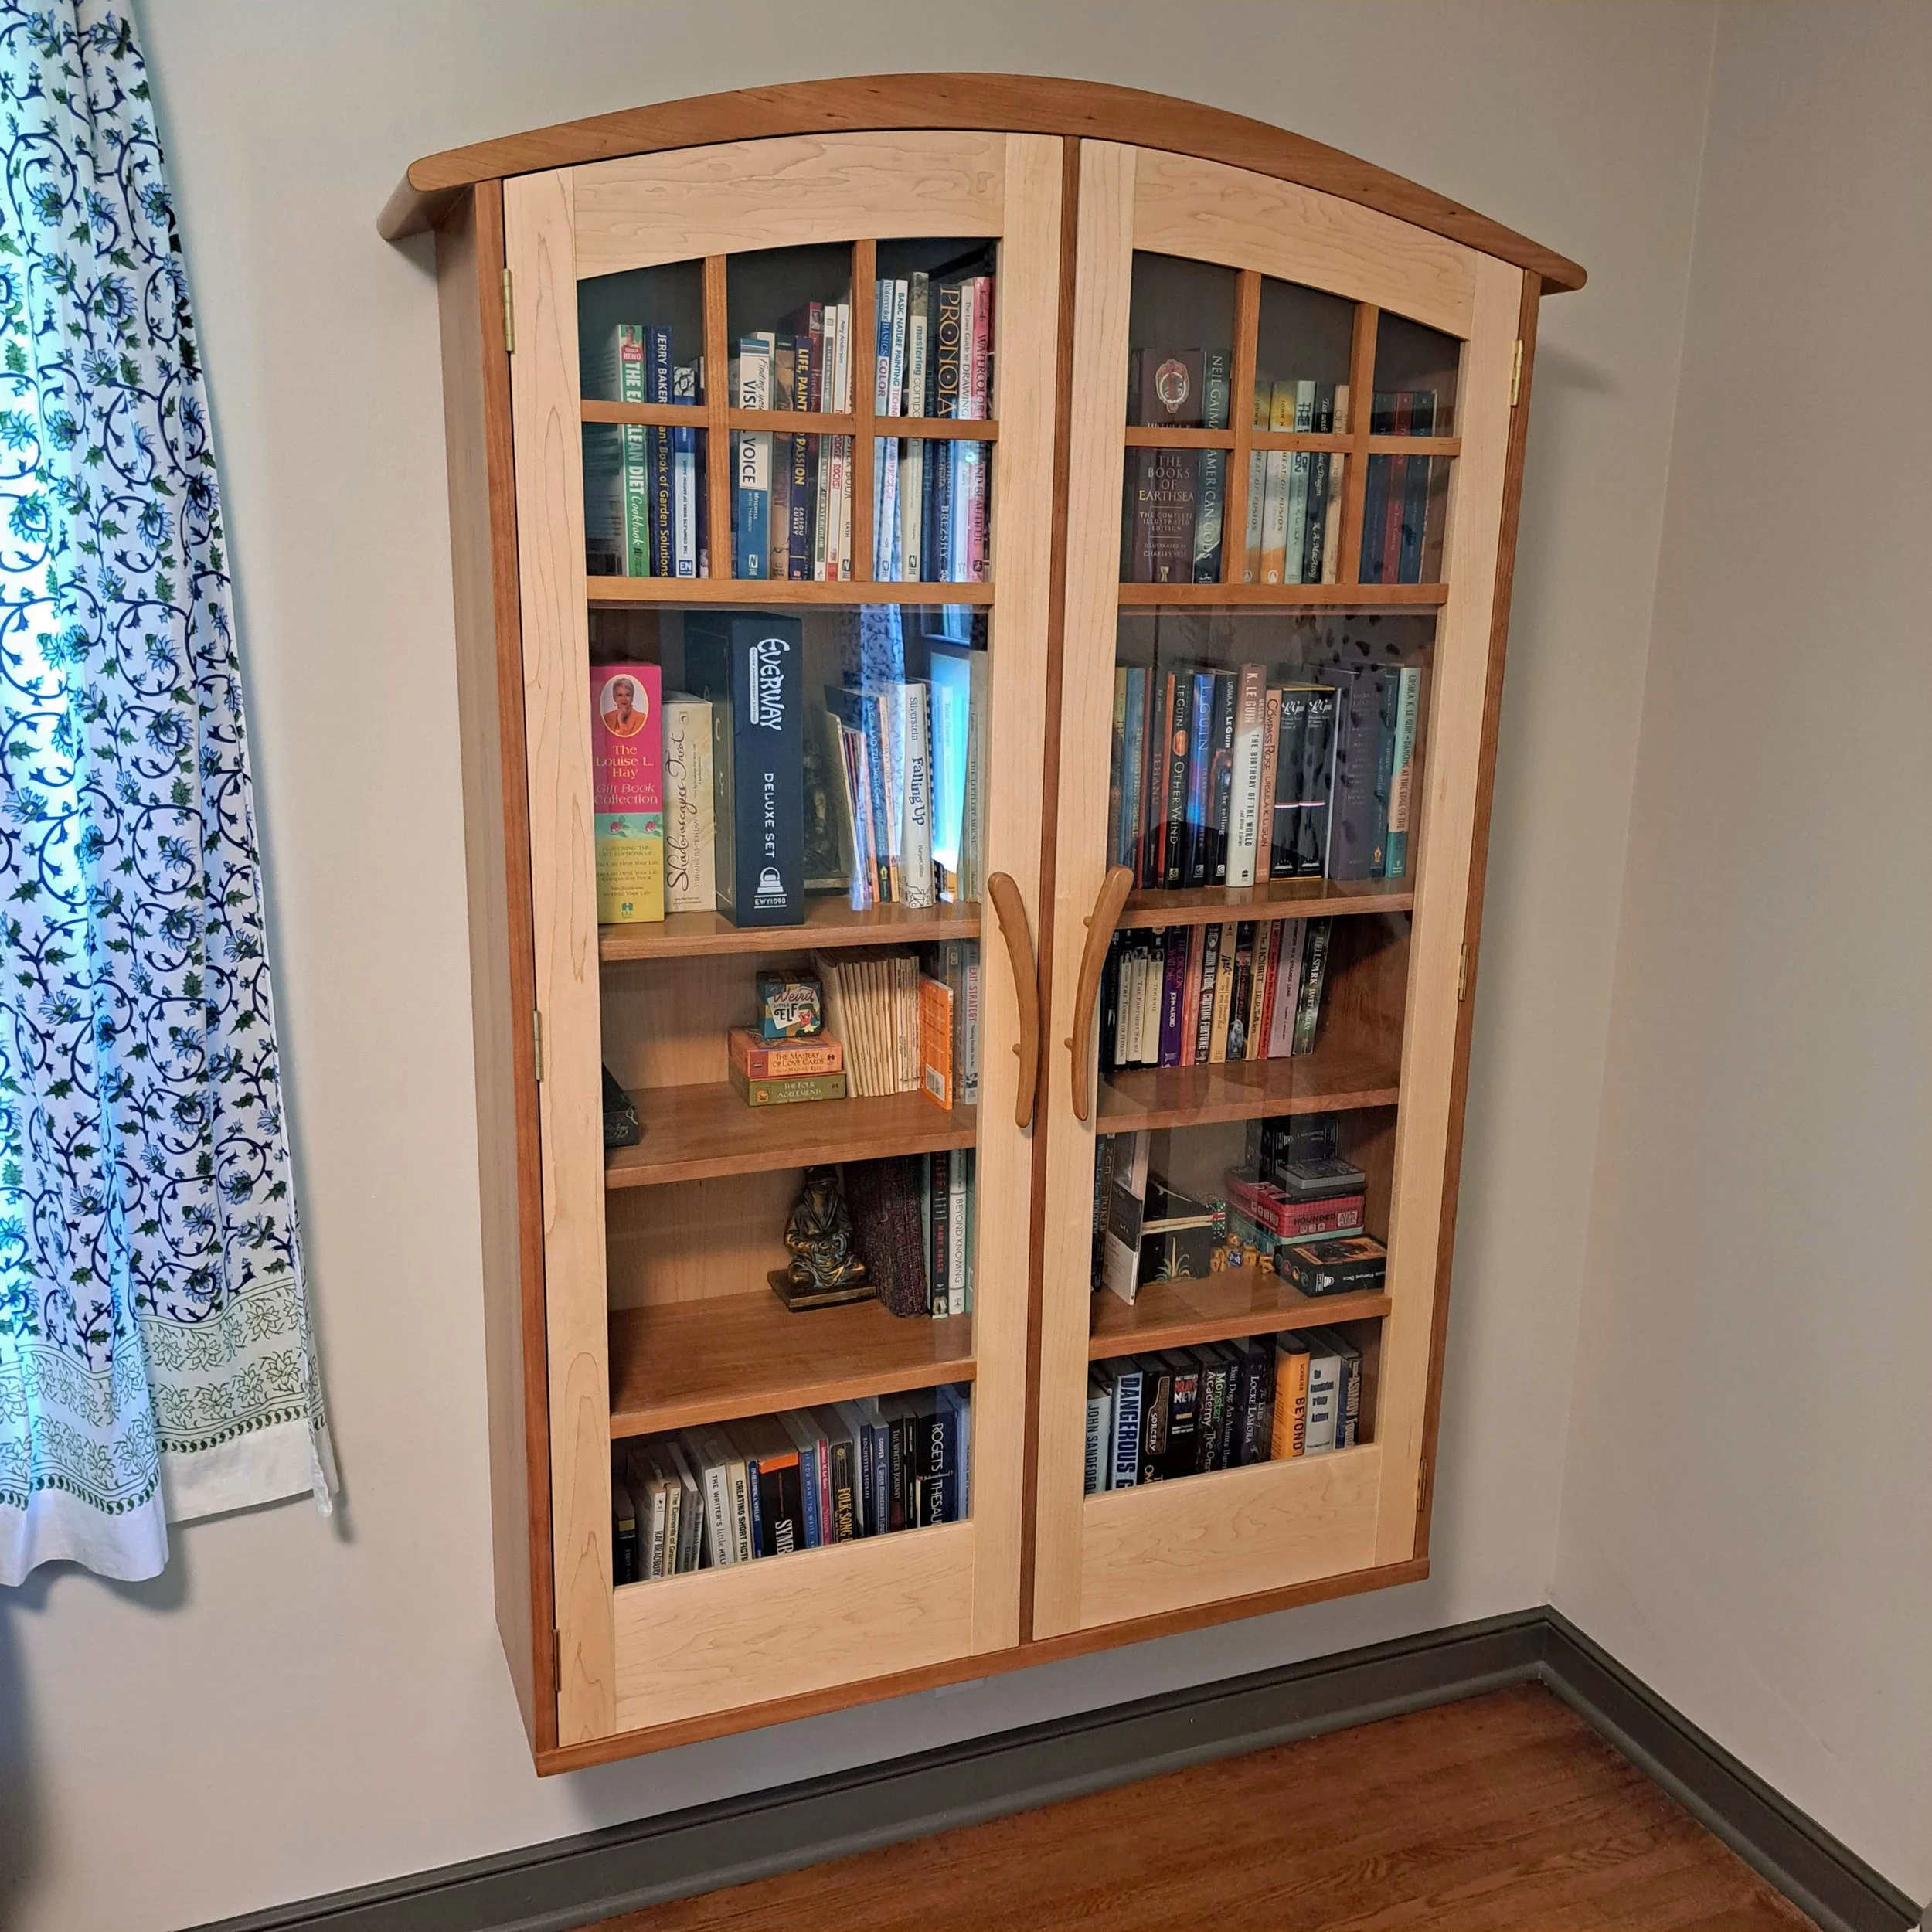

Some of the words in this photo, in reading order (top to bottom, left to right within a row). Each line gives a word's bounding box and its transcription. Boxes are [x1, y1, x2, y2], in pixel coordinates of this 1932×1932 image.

[897, 292, 906, 315] BASIC
[880, 321, 891, 357] BASICS
[896, 318, 904, 347] NATURE
[657, 332, 667, 365] JERRY
[797, 348, 809, 374] LIFE,
[913, 325, 923, 376] mastering
[937, 288, 961, 416] PRONOIA
[624, 362, 641, 387] THE
[878, 359, 888, 396] COLOR
[893, 350, 902, 386] PAINTING
[975, 335, 987, 410] WATERCOLOR
[1211, 355, 1223, 386] NEIL
[658, 368, 668, 404] BAKER
[797, 376, 808, 412] PAINT
[961, 363, 970, 417] DRAWING
[659, 447, 668, 472] Book
[743, 437, 757, 484] VOICE
[794, 438, 807, 485] PASSION
[1148, 467, 1191, 478] BOOKS
[1158, 456, 1182, 468] THE
[628, 465, 645, 495] DIET
[659, 476, 669, 488] of
[1161, 478, 1178, 491] OF
[1203, 448, 1218, 519] AMERICAN
[659, 490, 669, 527] Garden
[1138, 490, 1195, 502] EARTHSEA
[631, 495, 644, 546] Cookbook
[660, 530, 670, 577] Solutions
[1202, 522, 1214, 560] GODS
[1245, 686, 1257, 696] LE
[1246, 672, 1258, 682] K.
[909, 696, 920, 741] Silverstein
[1244, 700, 1257, 724] GUIN
[1265, 698, 1278, 744] COMPASS
[612, 745, 638, 756] The
[665, 729, 687, 781] Tarot
[1250, 733, 1260, 747] THE
[596, 755, 639, 767] Louise
[642, 757, 655, 767] L.
[1247, 751, 1257, 788] BIRTHDAY
[1263, 744, 1275, 770] ROSE
[596, 783, 618, 794] Gift
[621, 783, 655, 794] Book
[611, 767, 638, 780] Hay
[908, 756, 924, 805] Falling
[1171, 761, 1185, 803] OTHER
[594, 794, 658, 805] Collection
[764, 773, 775, 828] DELUXE
[1246, 804, 1255, 818] THE
[1247, 792, 1255, 801] OF
[911, 800, 926, 827] Up
[1168, 805, 1182, 844] WIND
[666, 781, 698, 892] Shadowscapes
[764, 832, 775, 858] SET
[1244, 821, 1253, 846] WORLD
[754, 897, 786, 906] EWY1090
[968, 967, 978, 985] EXIT
[1257, 947, 1267, 982] HOBBIT
[1309, 937, 1325, 985] HELLSPARK
[770, 985, 818, 1003] Weird
[968, 985, 978, 1022] STRATEGY
[774, 1003, 799, 1022] ELF
[782, 1059, 802, 1068] LOVE
[790, 1051, 821, 1061] MASTERY
[777, 1088, 822, 1099] AGREEMENTS
[954, 1198, 964, 1236] BEYOND
[1293, 1213, 1336, 1226] HOUNDED
[954, 1238, 964, 1284] KNOWING
[1230, 1366, 1239, 1383] Bait
[1173, 1389, 1197, 1404] NEW
[1200, 1371, 1216, 1427] Academy
[1212, 1372, 1226, 1422] Monster
[1248, 1376, 1260, 1406] LOCKE
[1087, 1404, 1100, 1434] JOHN
[1116, 1377, 1141, 1474] DANGEROUS
[1226, 1406, 1235, 1417] An
[1245, 1407, 1257, 1444] LAMORA
[1293, 1396, 1305, 1450] BEYOND
[1149, 1412, 1158, 1452] SORCERY
[1224, 1418, 1233, 1448] Atlanta
[1084, 1435, 1099, 1491] SANDFORD
[672, 1493, 680, 1503] The
[735, 1480, 746, 1515] CREATING
[838, 1487, 852, 1510] FOLK
[893, 1472, 901, 1499] JOURNEY
[670, 1506, 679, 1536] Elements
[713, 1491, 723, 1527] WRITER'S
[807, 1501, 812, 1512] TO
[655, 1530, 663, 1543] RAY
[716, 1527, 727, 1548] little
[738, 1517, 747, 1540] SHORT
[838, 1512, 853, 1538] SONG
[669, 1536, 675, 1545] of
